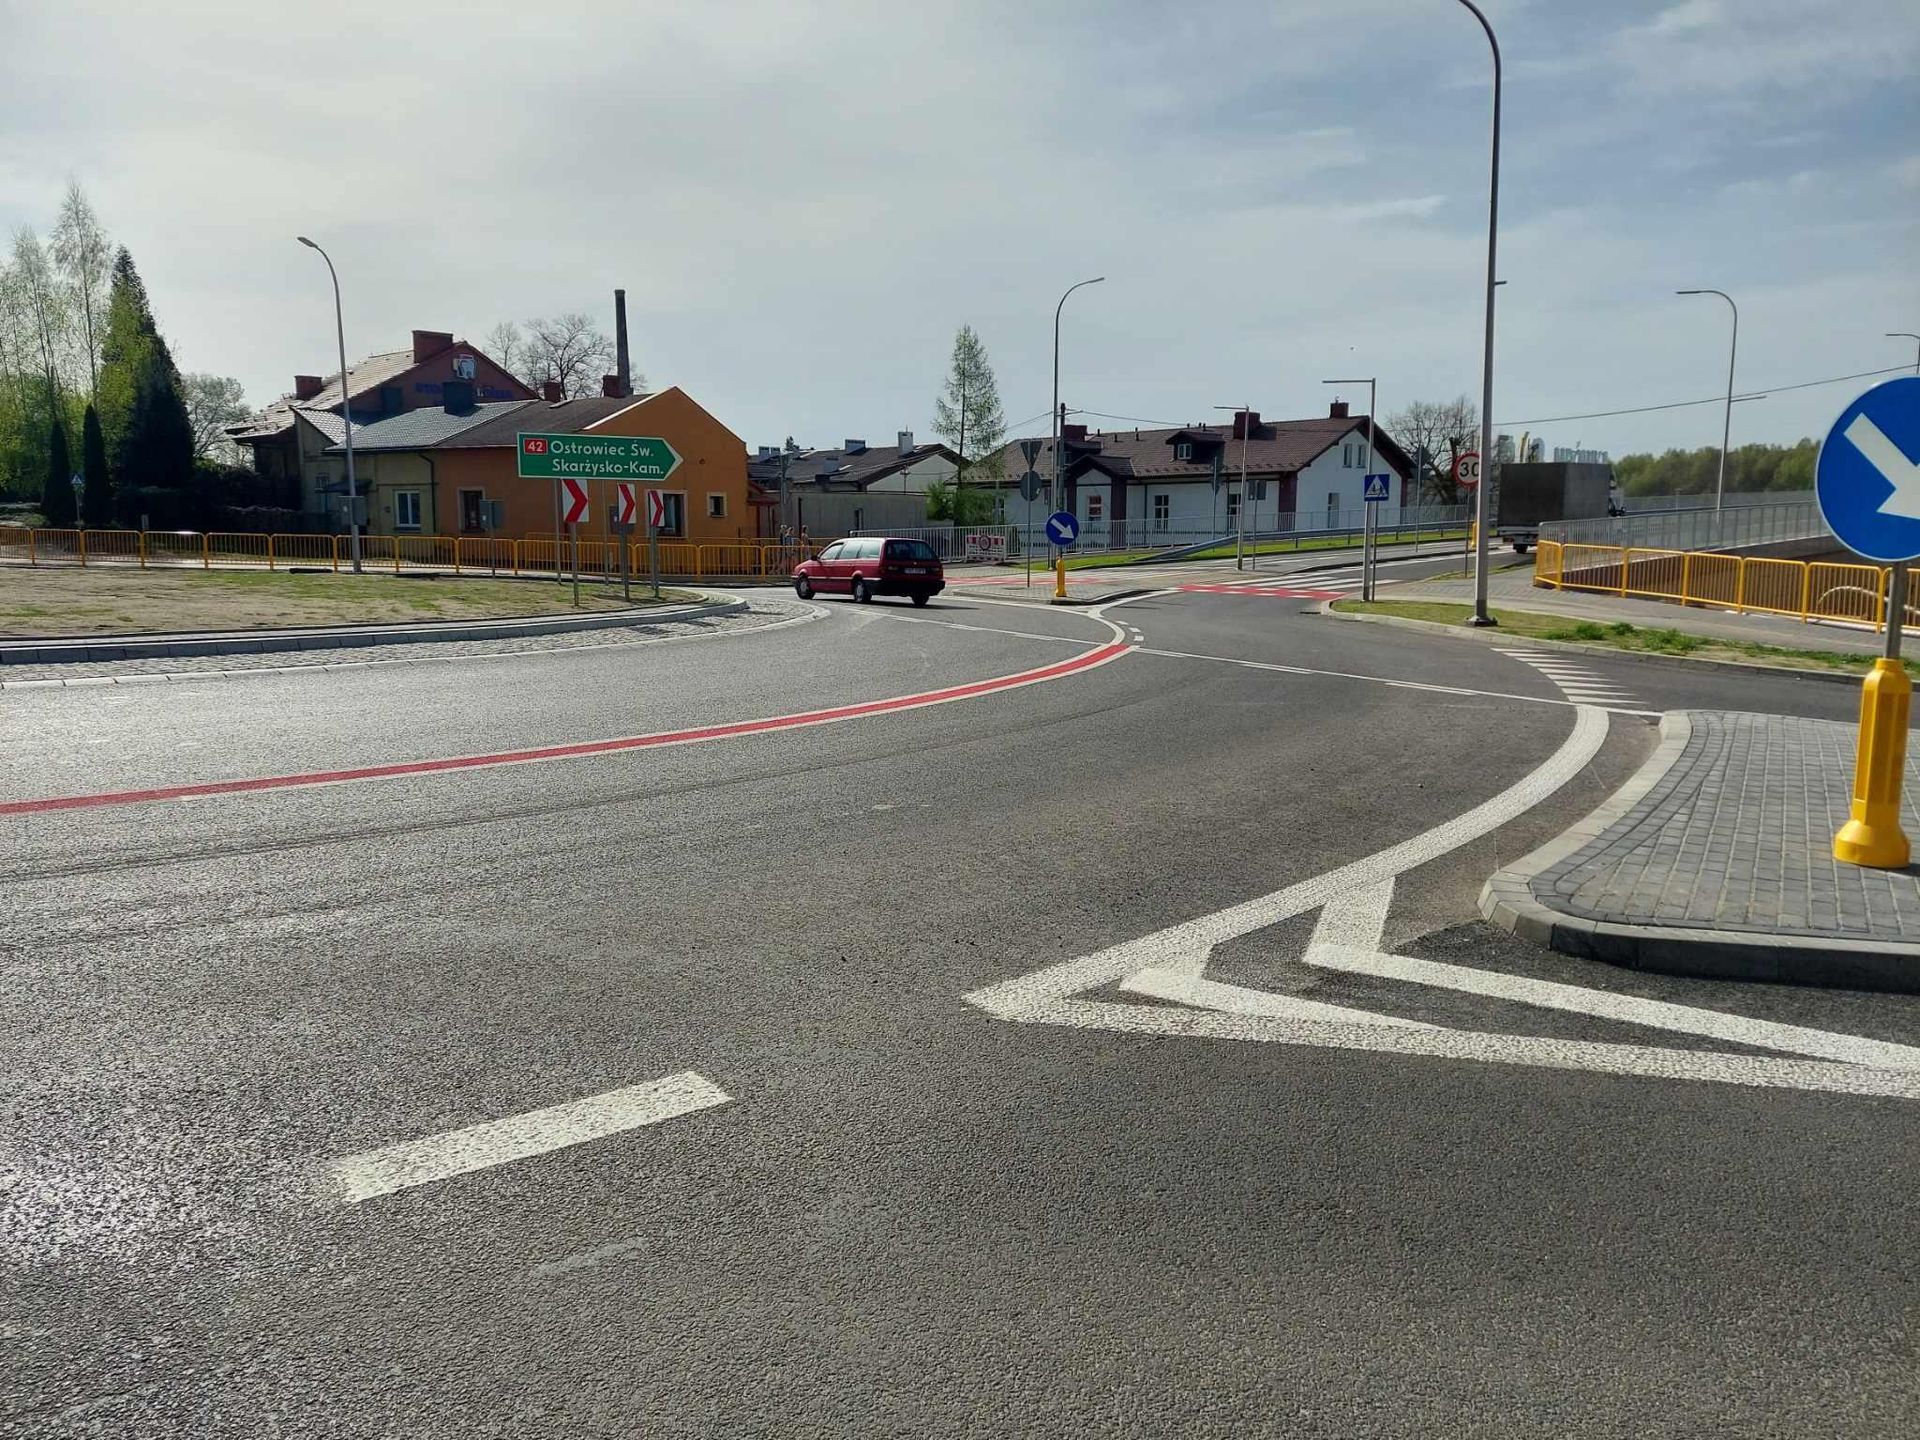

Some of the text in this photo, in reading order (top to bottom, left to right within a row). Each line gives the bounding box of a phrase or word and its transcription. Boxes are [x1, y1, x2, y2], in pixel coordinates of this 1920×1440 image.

[527, 440, 654, 457] 42 Ostrowiec Św.
[552, 458, 664, 475] Skarżysko-Kam.
